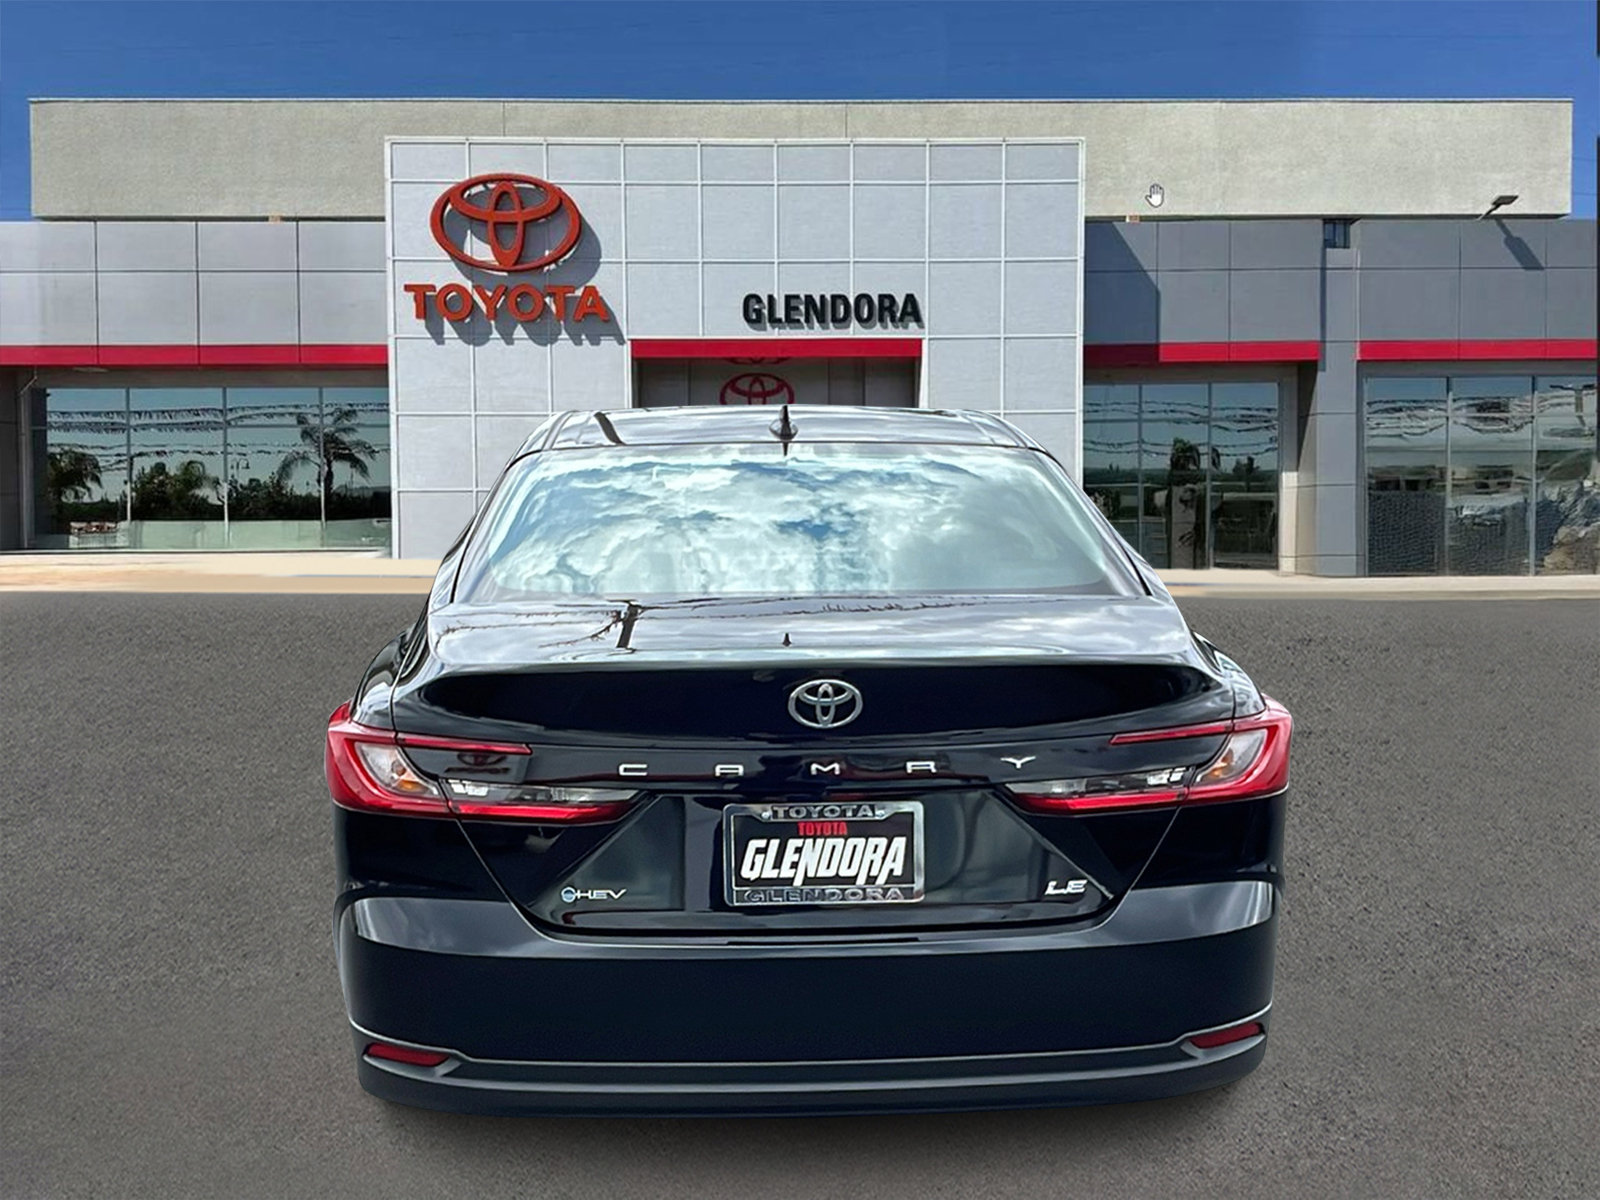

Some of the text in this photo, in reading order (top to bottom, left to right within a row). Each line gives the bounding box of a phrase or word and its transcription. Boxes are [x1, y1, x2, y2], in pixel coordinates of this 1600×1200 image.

[404, 284, 610, 323] TOYOTA
[742, 293, 923, 325] GLENDORA
[771, 805, 875, 818] TOYOTA
[798, 822, 847, 835] TOYOTA
[740, 836, 907, 886] GLENDORA
[744, 887, 905, 903] GLENDORA
[1044, 879, 1088, 895] LE
